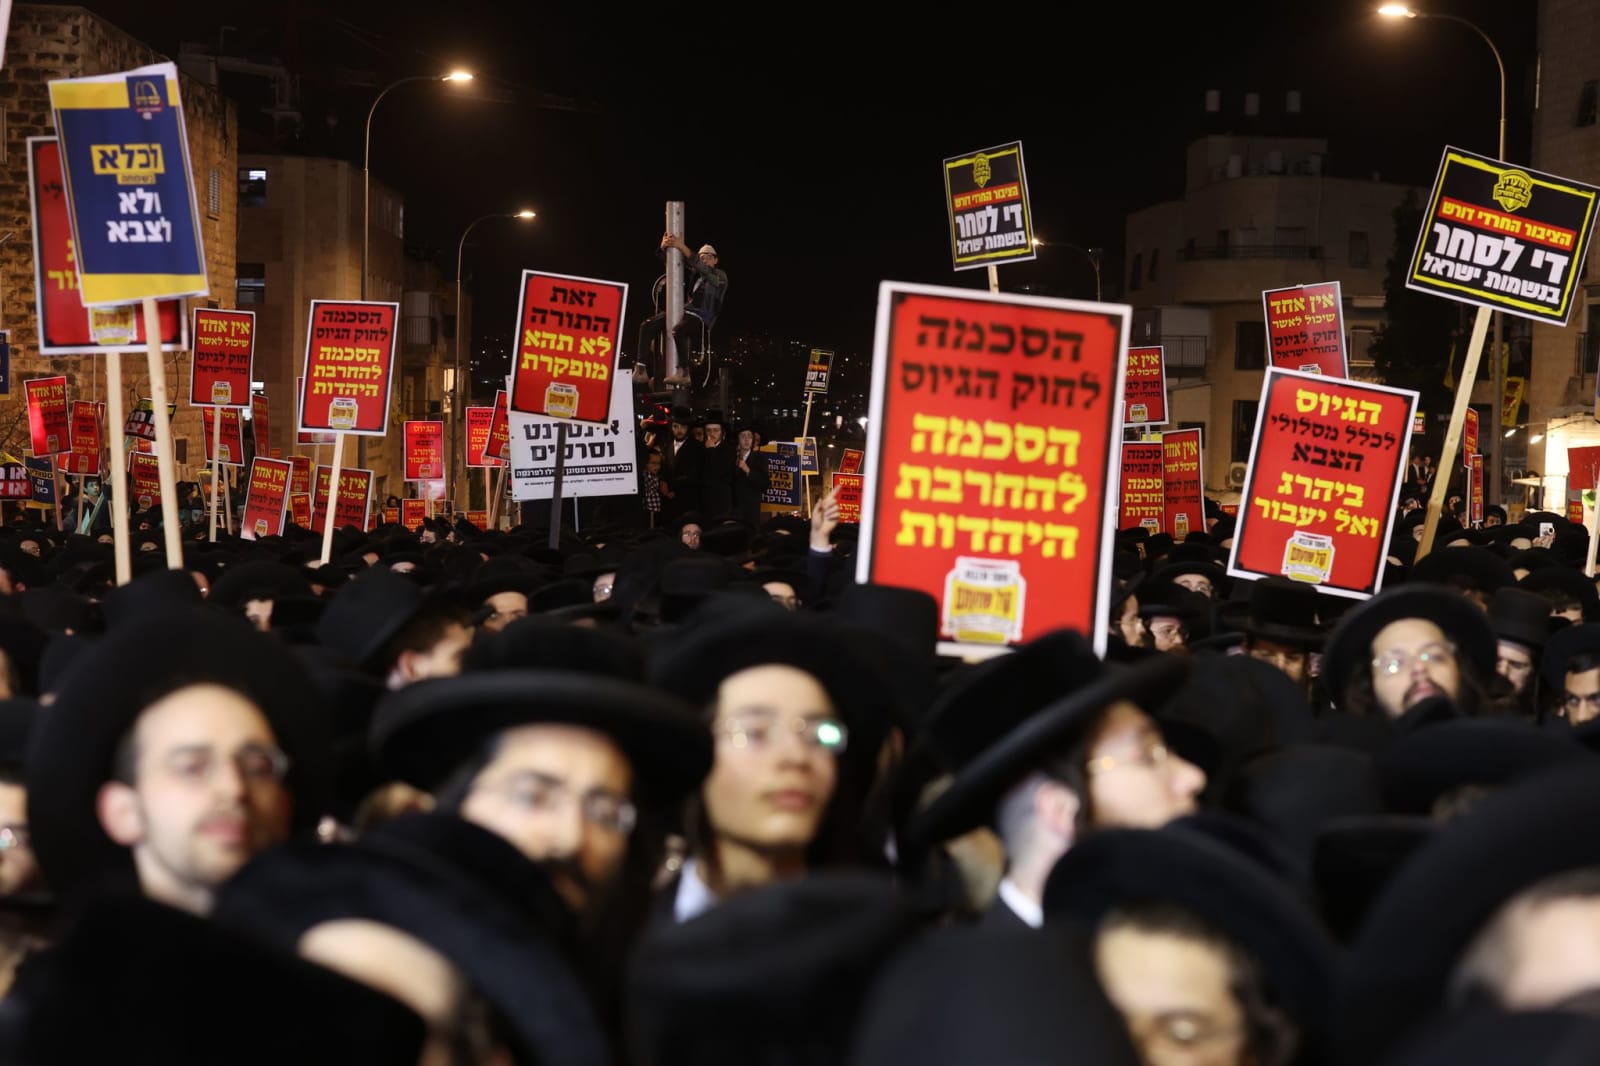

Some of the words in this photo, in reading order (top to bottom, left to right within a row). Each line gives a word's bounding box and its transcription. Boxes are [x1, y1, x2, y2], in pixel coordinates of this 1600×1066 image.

[98, 144, 159, 169] וכלא
[118, 188, 162, 214] ולא
[954, 195, 971, 208] דורש
[972, 190, 992, 203] החרדי
[994, 185, 1018, 199] הציבור
[1003, 203, 1022, 228] די
[1442, 201, 1474, 221] דורש
[106, 216, 172, 242] לצבא
[955, 205, 998, 238] לסחר
[1478, 210, 1522, 233] החרדי
[985, 230, 1026, 250] בנשמות
[1525, 223, 1572, 246] הציבור
[956, 238, 984, 255] ישראל
[1433, 222, 1525, 272] לסחר
[1422, 252, 1482, 282] ישראל
[1530, 248, 1570, 284] די
[550, 286, 597, 307] זאת
[1483, 270, 1562, 304] בנשמות
[1270, 297, 1306, 314] אחד
[1309, 294, 1334, 313] אין
[200, 318, 228, 333] אחד
[322, 310, 382, 324] הסכמה
[531, 307, 611, 333] התורה
[1272, 316, 1302, 328] לאשר
[1304, 314, 1336, 325] שיכול
[231, 320, 250, 336] אין
[316, 326, 350, 340] הגיוס
[354, 327, 388, 342] לחוק
[1312, 330, 1336, 344] חוק
[225, 336, 249, 348] שיכול
[524, 329, 574, 352] תהא
[579, 336, 612, 357] לא
[917, 315, 1085, 362] הסכמה
[1274, 331, 1308, 346] לגיוס
[319, 346, 380, 362] הסכמה
[1141, 354, 1160, 367] אין
[1276, 348, 1308, 358] ישראל
[313, 364, 382, 380] להחרבת
[521, 352, 609, 381] מופקרת
[312, 382, 379, 396] היהדות
[902, 361, 1000, 400] הגיוס
[1011, 371, 1102, 410] לחוק
[1296, 388, 1382, 424] הגיוס
[524, 420, 620, 440] אנטנט
[1271, 413, 1340, 440] מסלולי
[911, 413, 1081, 467] הסכמה
[1344, 424, 1396, 450] לכלל
[1127, 450, 1162, 460] סכמה
[1164, 443, 1181, 458] אחד
[1182, 441, 1198, 460] אין
[1292, 442, 1364, 472] הצבא
[256, 466, 272, 478] אחד
[274, 469, 286, 482] אין
[348, 475, 366, 490] אין
[894, 462, 1088, 514] להחרבת
[1128, 478, 1162, 489] סכמה
[1277, 472, 1365, 508] ביהרג
[1125, 492, 1163, 503] החרבת
[1126, 506, 1163, 516] יהדות
[1255, 497, 1328, 527] יעבור
[1334, 508, 1380, 538] ואל
[896, 509, 1080, 560] היהדות
